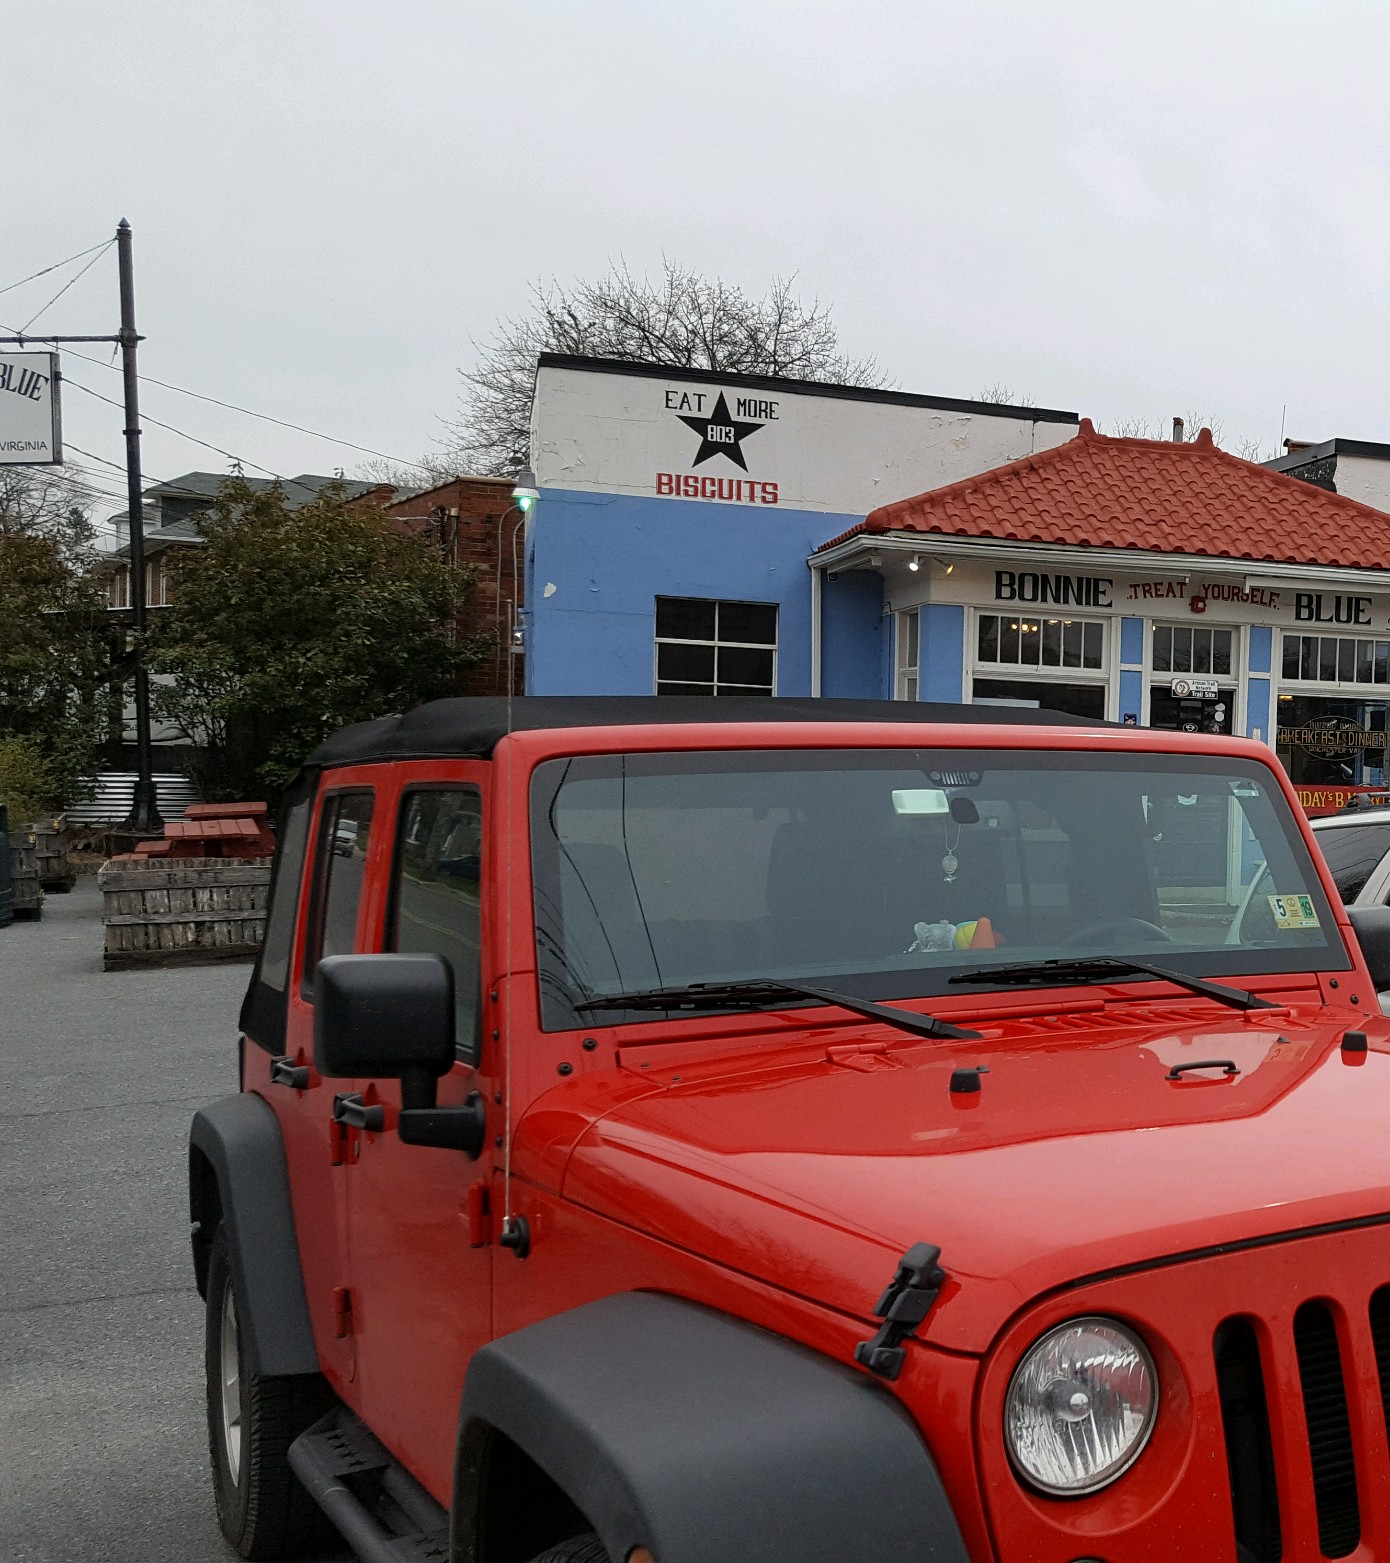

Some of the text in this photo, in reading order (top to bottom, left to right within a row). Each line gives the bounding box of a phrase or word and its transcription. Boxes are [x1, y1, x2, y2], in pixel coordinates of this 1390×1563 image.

[0, 362, 49, 401] BLUE
[664, 389, 780, 420] EAT MORE
[0, 441, 48, 451] VIRGINIA
[707, 424, 735, 443] 803
[655, 472, 779, 505] BISCUITS
[994, 570, 1114, 608] BONNIE
[1294, 592, 1373, 625] BLUE
[1280, 728, 1341, 745] BREAKFAST
[1348, 731, 1386, 747] DINNER
[1275, 898, 1287, 917] 5
